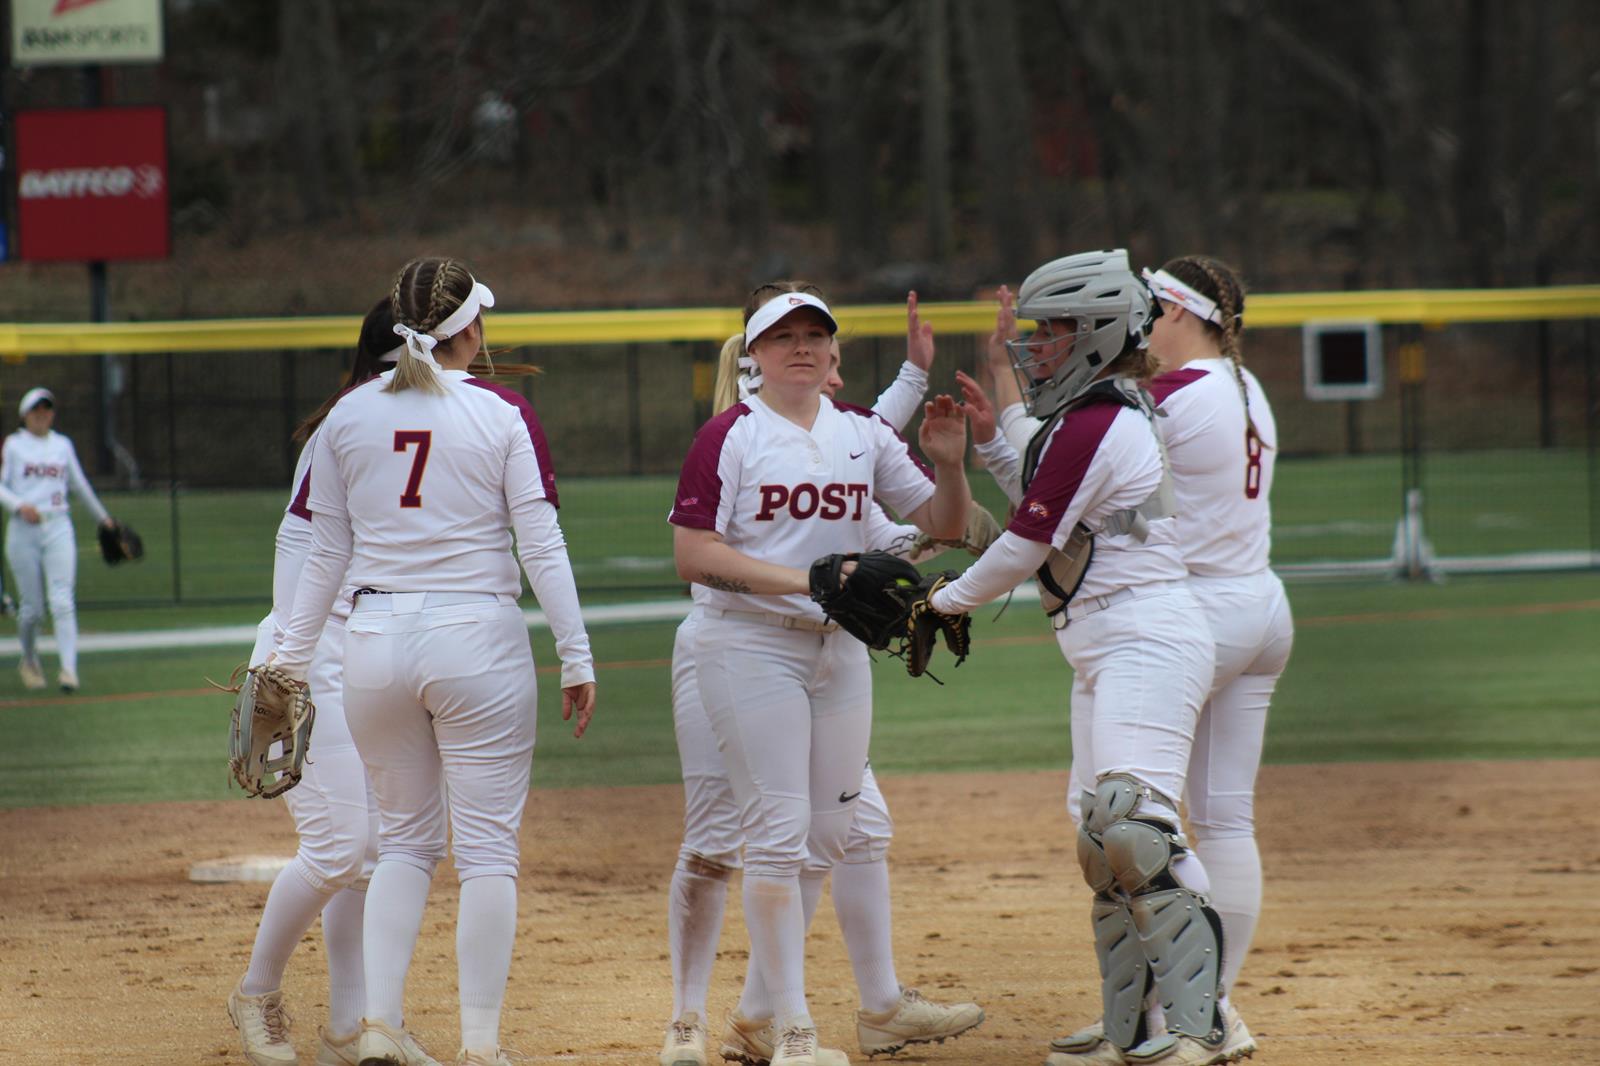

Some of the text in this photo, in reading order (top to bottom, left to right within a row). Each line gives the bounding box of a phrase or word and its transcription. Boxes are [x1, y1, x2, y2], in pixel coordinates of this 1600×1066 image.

[393, 430, 432, 509] 7
[1245, 427, 1262, 500] 8
[755, 483, 869, 521] POST
